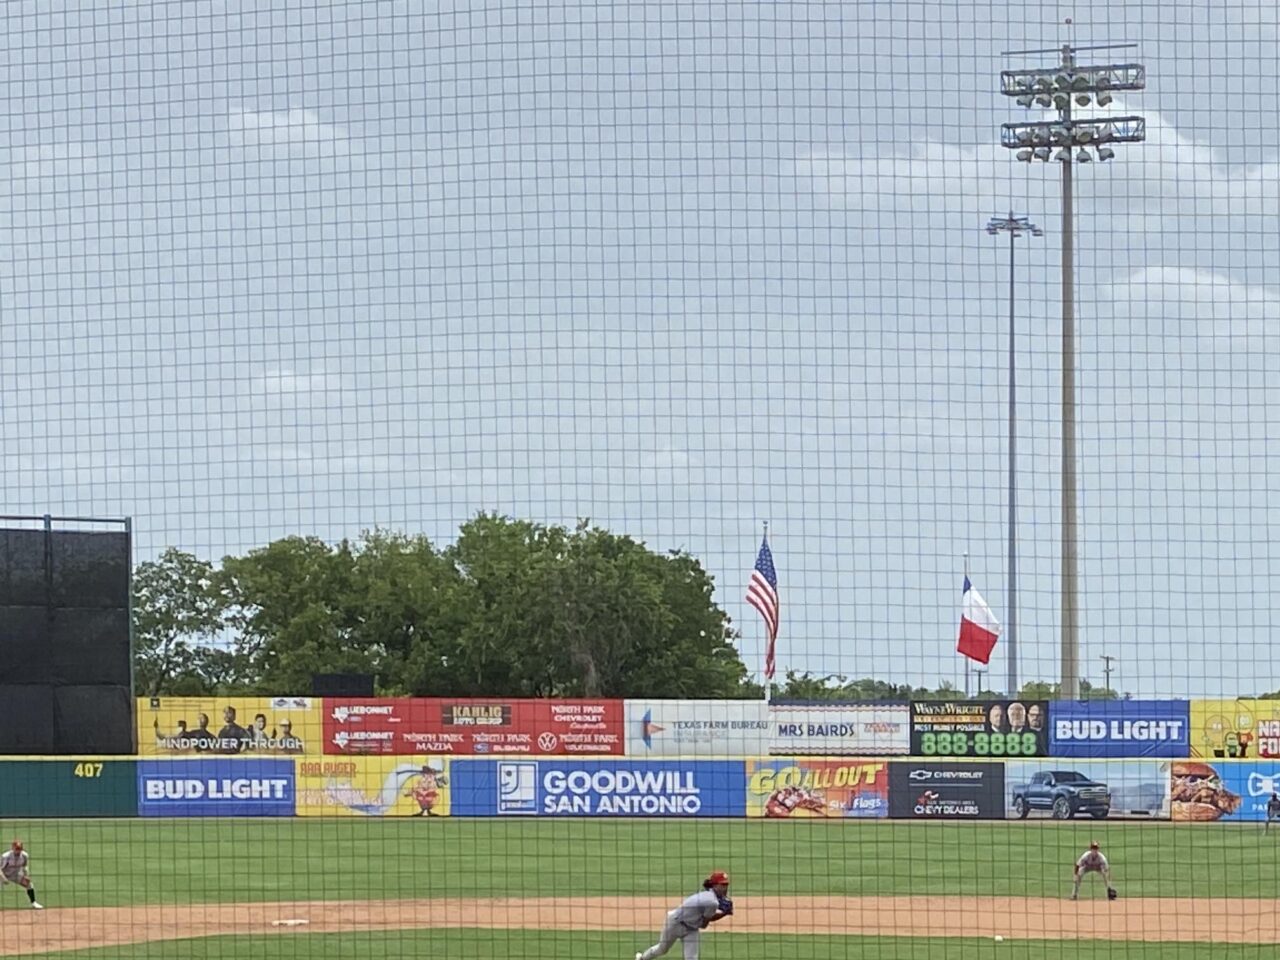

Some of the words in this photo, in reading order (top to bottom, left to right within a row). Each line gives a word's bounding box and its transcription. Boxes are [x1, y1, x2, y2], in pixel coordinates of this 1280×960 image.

[551, 705, 581, 713] NORTH
[584, 705, 606, 713] PARK
[673, 721, 701, 729] TEXAS
[704, 721, 728, 729] FARM
[731, 720, 768, 729] BUREAU
[778, 723, 803, 737] MRS
[807, 722, 855, 737] BAIRD'S
[1056, 720, 1108, 741] BUD
[1110, 720, 1183, 741] LIGHT
[240, 737, 305, 750] THROUGH
[507, 733, 532, 742] PARK
[593, 733, 619, 743] PARK
[921, 732, 1037, 755] 888-8888
[416, 742, 453, 751] MAZDA
[74, 763, 103, 778] 407
[323, 762, 357, 778] AUGER
[933, 771, 983, 779] CHEVROLET
[543, 770, 701, 794] GOODWILL
[750, 766, 801, 796] GO
[802, 768, 832, 790] ALL
[834, 763, 884, 787] OUT
[146, 780, 204, 799] BUD
[208, 779, 288, 799] LIGHT
[543, 796, 592, 814] SAN
[596, 795, 702, 814] ANTONIO
[914, 805, 943, 814] CHEVY
[944, 805, 979, 814] DEALERS
